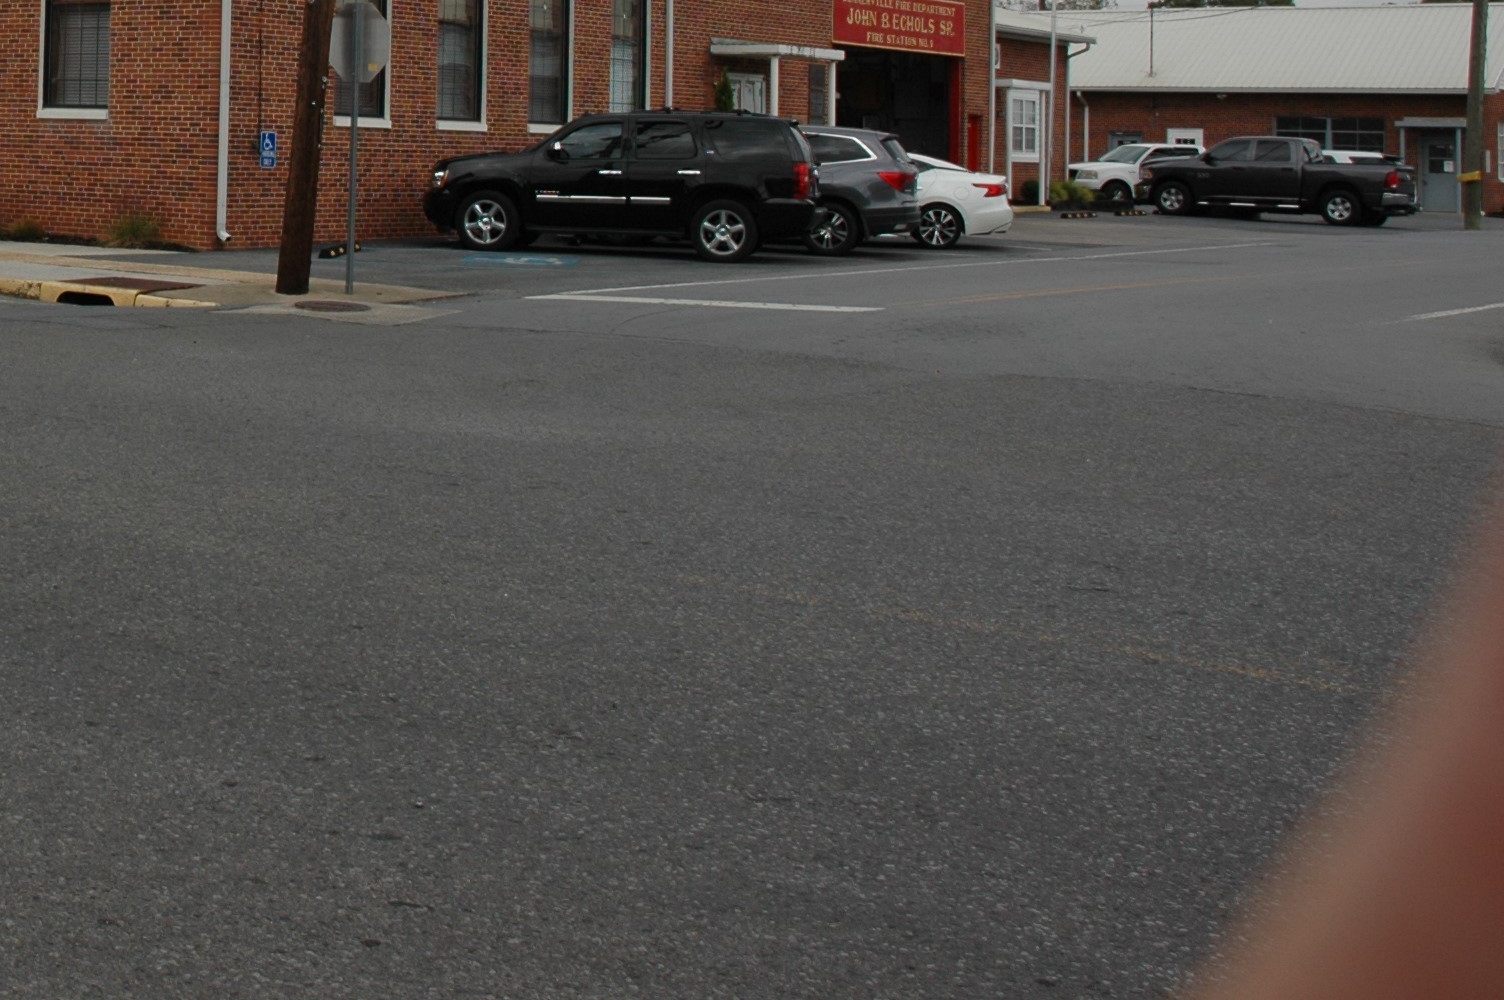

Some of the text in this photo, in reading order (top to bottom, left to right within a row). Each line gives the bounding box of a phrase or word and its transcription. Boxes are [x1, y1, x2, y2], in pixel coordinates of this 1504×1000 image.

[895, 0, 911, 12] FIRE
[912, 2, 956, 17] DEPARTMENT
[847, 8, 877, 26] JOHN
[892, 13, 935, 34] ECHOLS
[866, 31, 884, 43] FIRE
[886, 34, 917, 46] STATION
